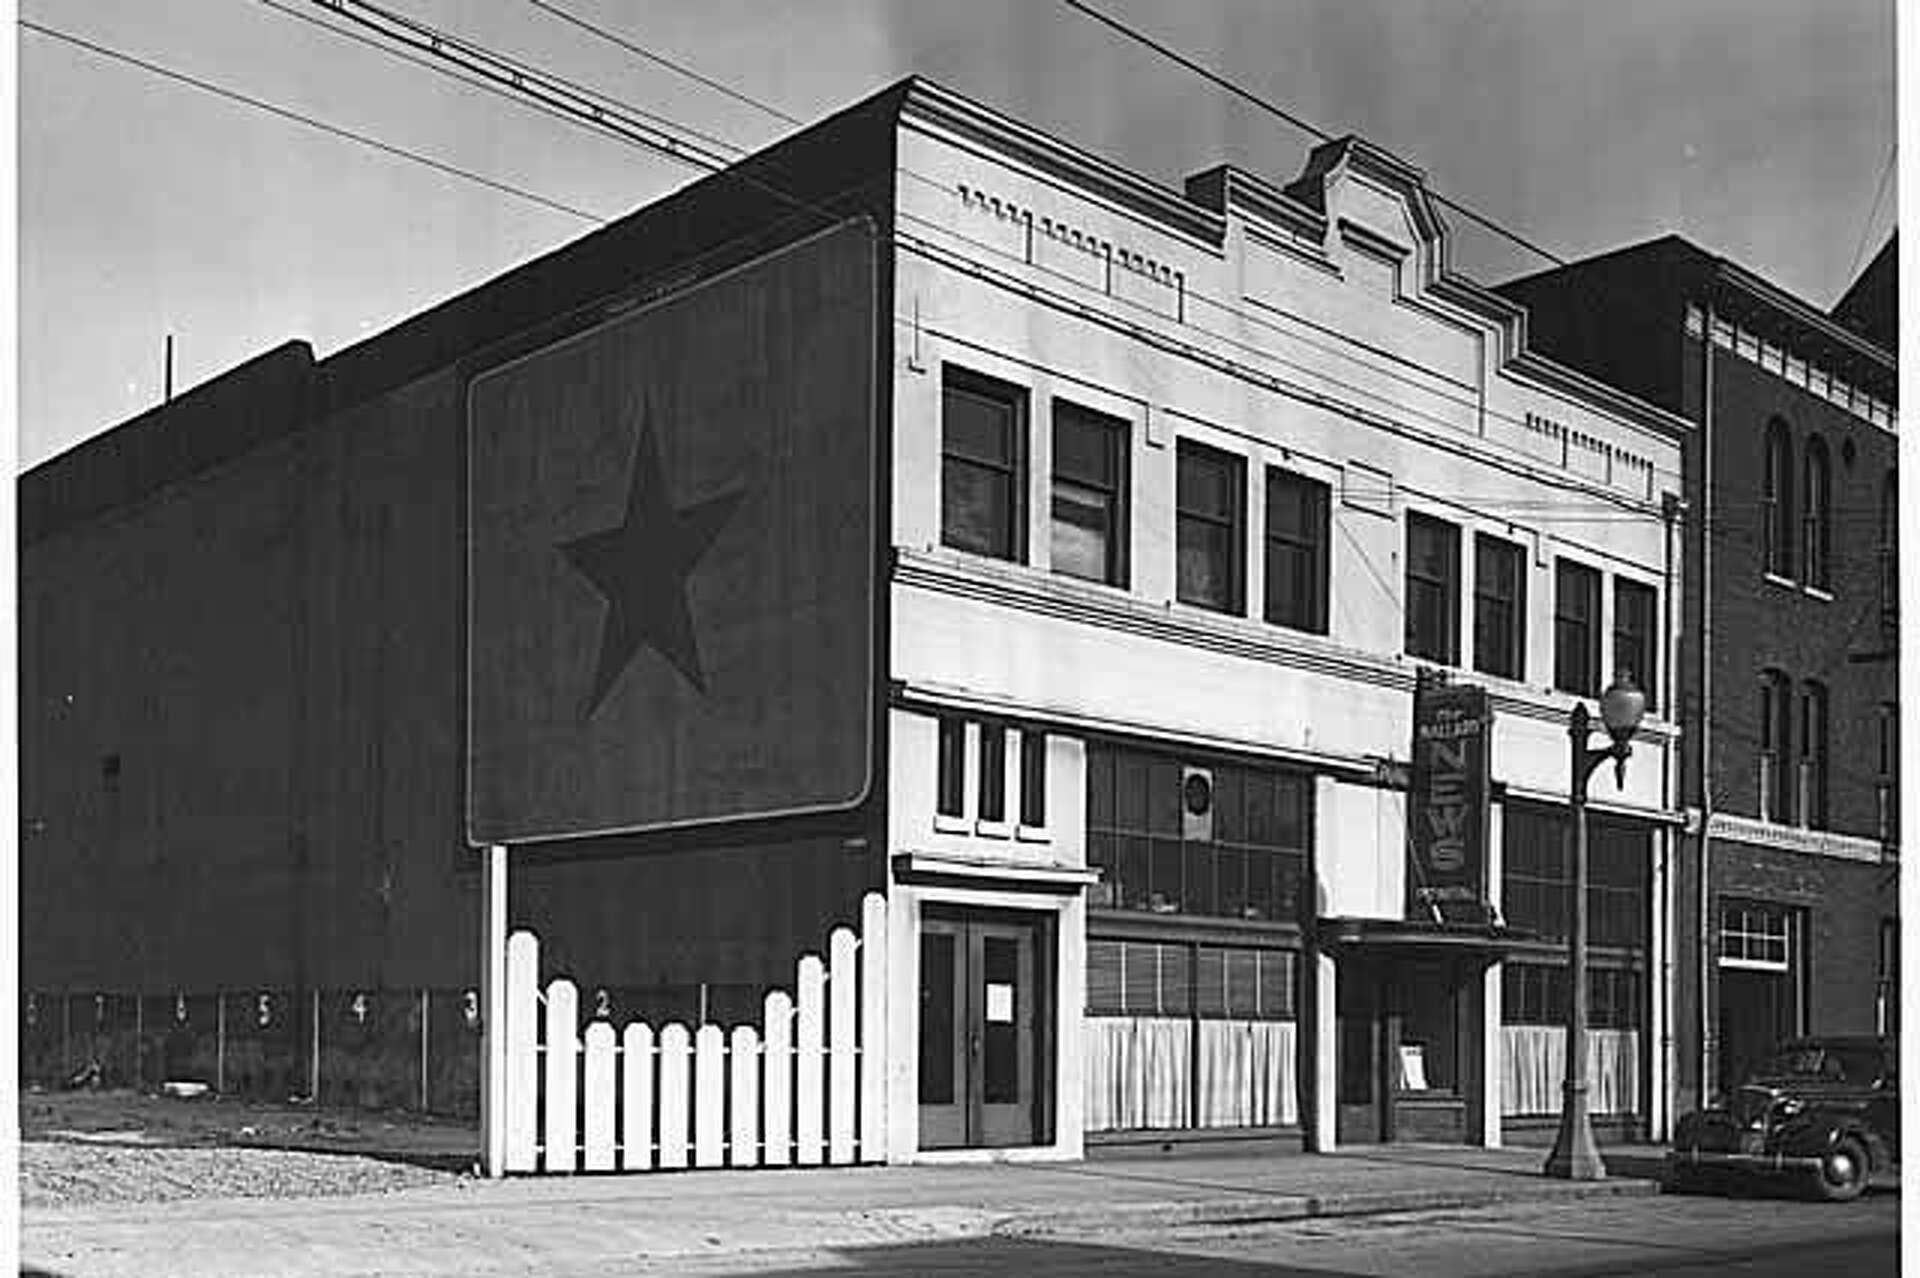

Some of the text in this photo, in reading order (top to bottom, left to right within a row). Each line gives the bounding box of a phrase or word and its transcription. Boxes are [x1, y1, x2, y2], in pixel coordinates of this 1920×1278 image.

[1426, 741, 1468, 871] NEWS
[258, 994, 271, 1025] 5
[352, 993, 367, 1024] 4
[464, 990, 478, 1023] 3
[596, 989, 611, 1017] 2
